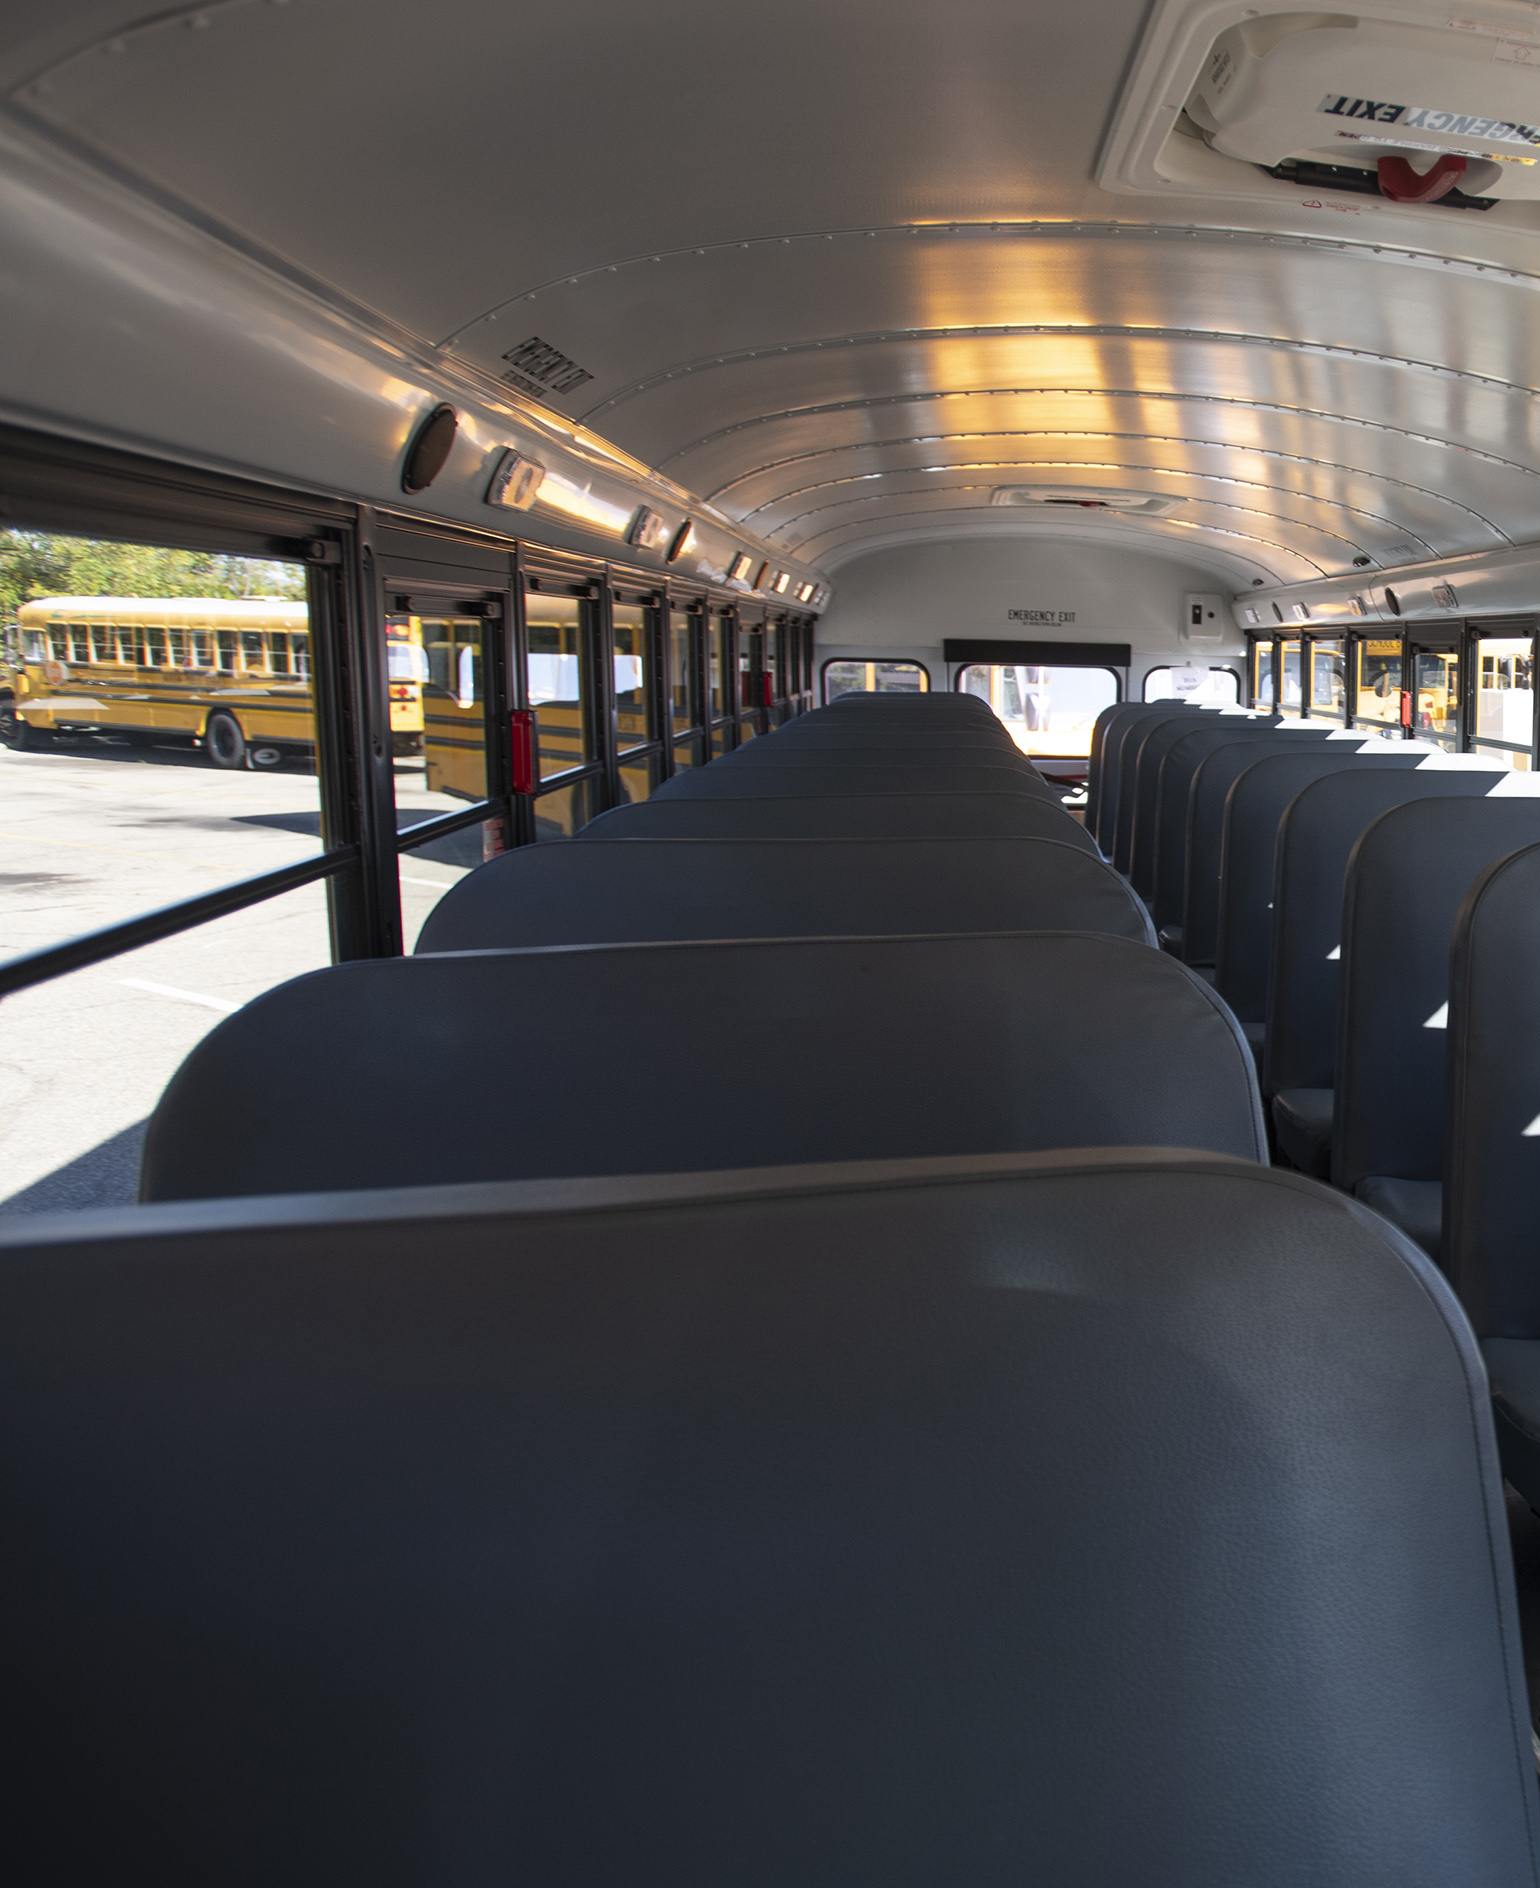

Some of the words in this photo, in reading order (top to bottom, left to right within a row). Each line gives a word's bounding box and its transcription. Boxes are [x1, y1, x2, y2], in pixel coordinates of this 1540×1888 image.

[1324, 96, 1406, 124] EXIT
[1008, 609, 1055, 622] EMERGENCY
[1059, 611, 1076, 623] EXIT
